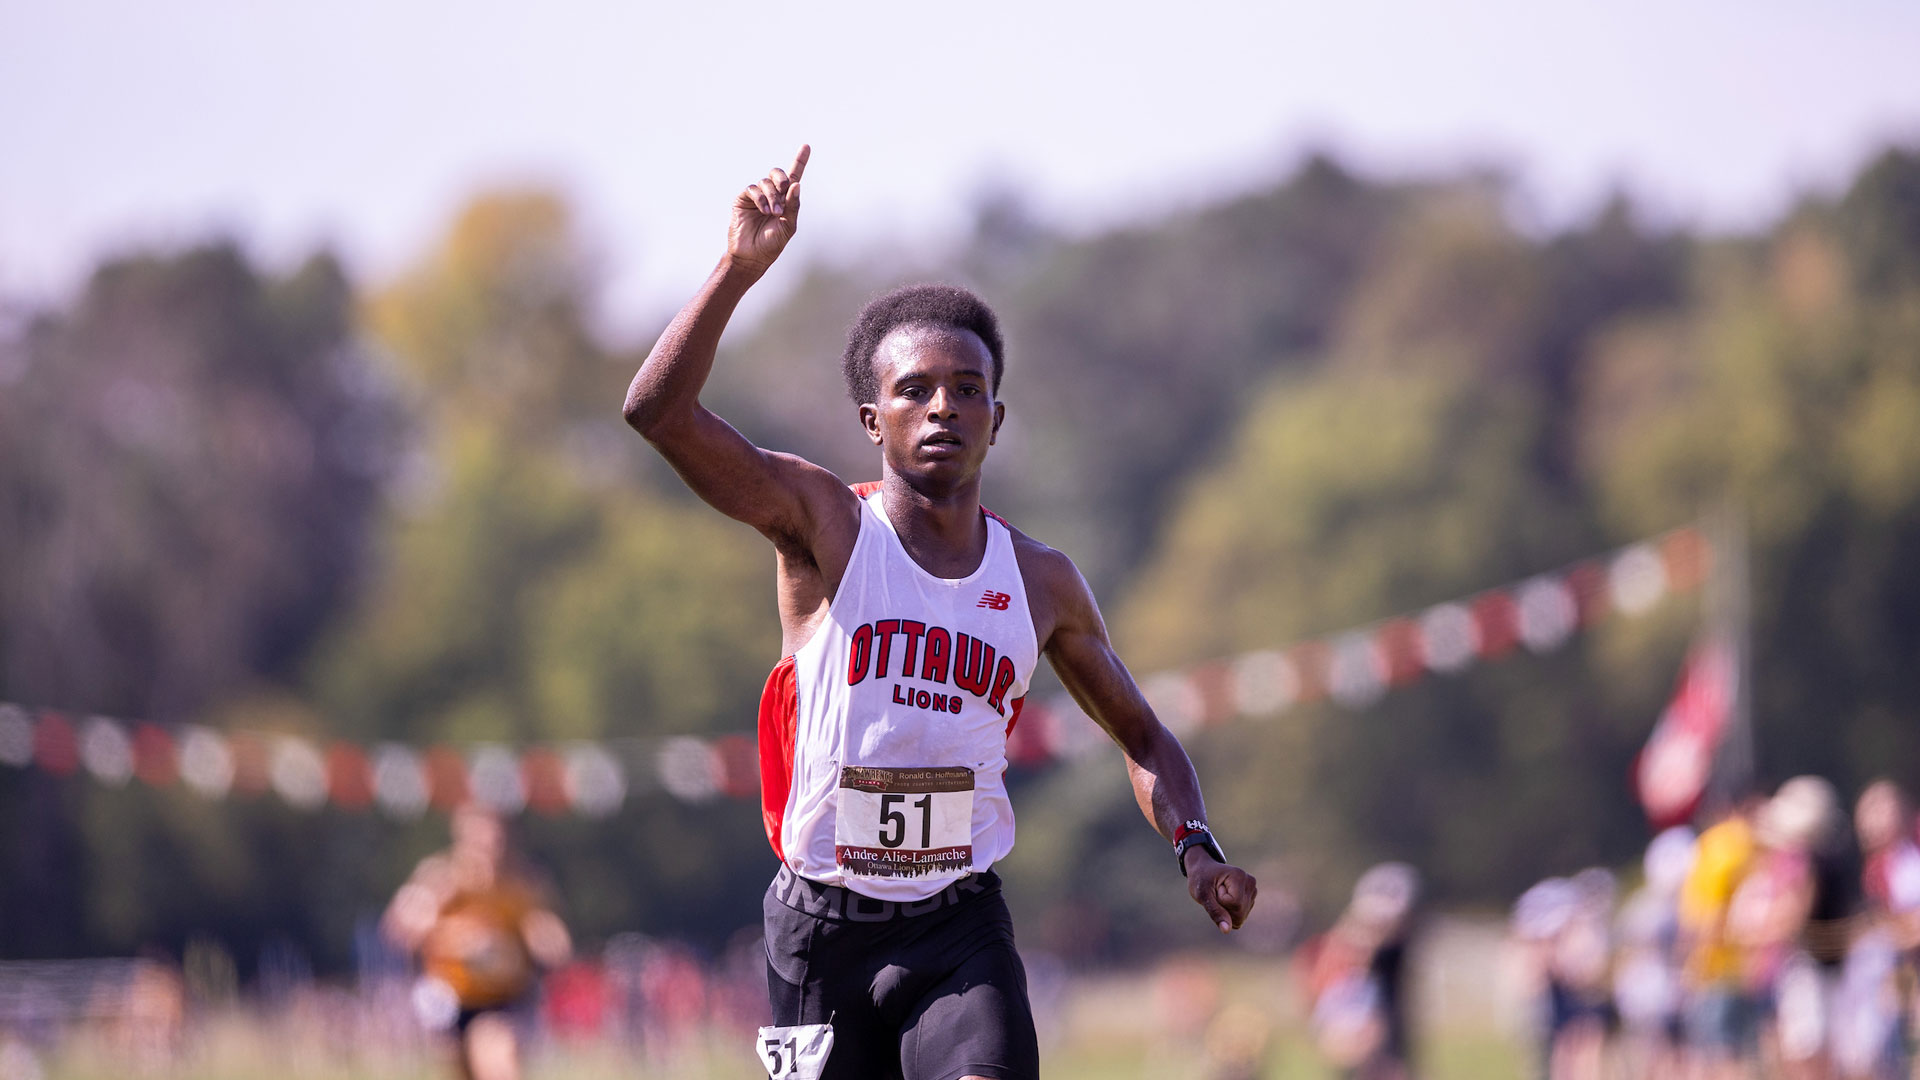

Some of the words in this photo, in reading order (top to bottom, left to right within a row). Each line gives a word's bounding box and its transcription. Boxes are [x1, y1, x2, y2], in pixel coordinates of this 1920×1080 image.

[847, 619, 1016, 717] OTTAWA
[892, 684, 963, 714] LIONS
[899, 772, 924, 780] Ronald
[935, 771, 968, 779] Hoffmann
[878, 794, 932, 848] 51
[842, 847, 878, 861] Andre
[882, 848, 967, 863] Alie-Lamarche
[867, 861, 892, 870] Ottawa
[765, 1037, 798, 1075] 51
